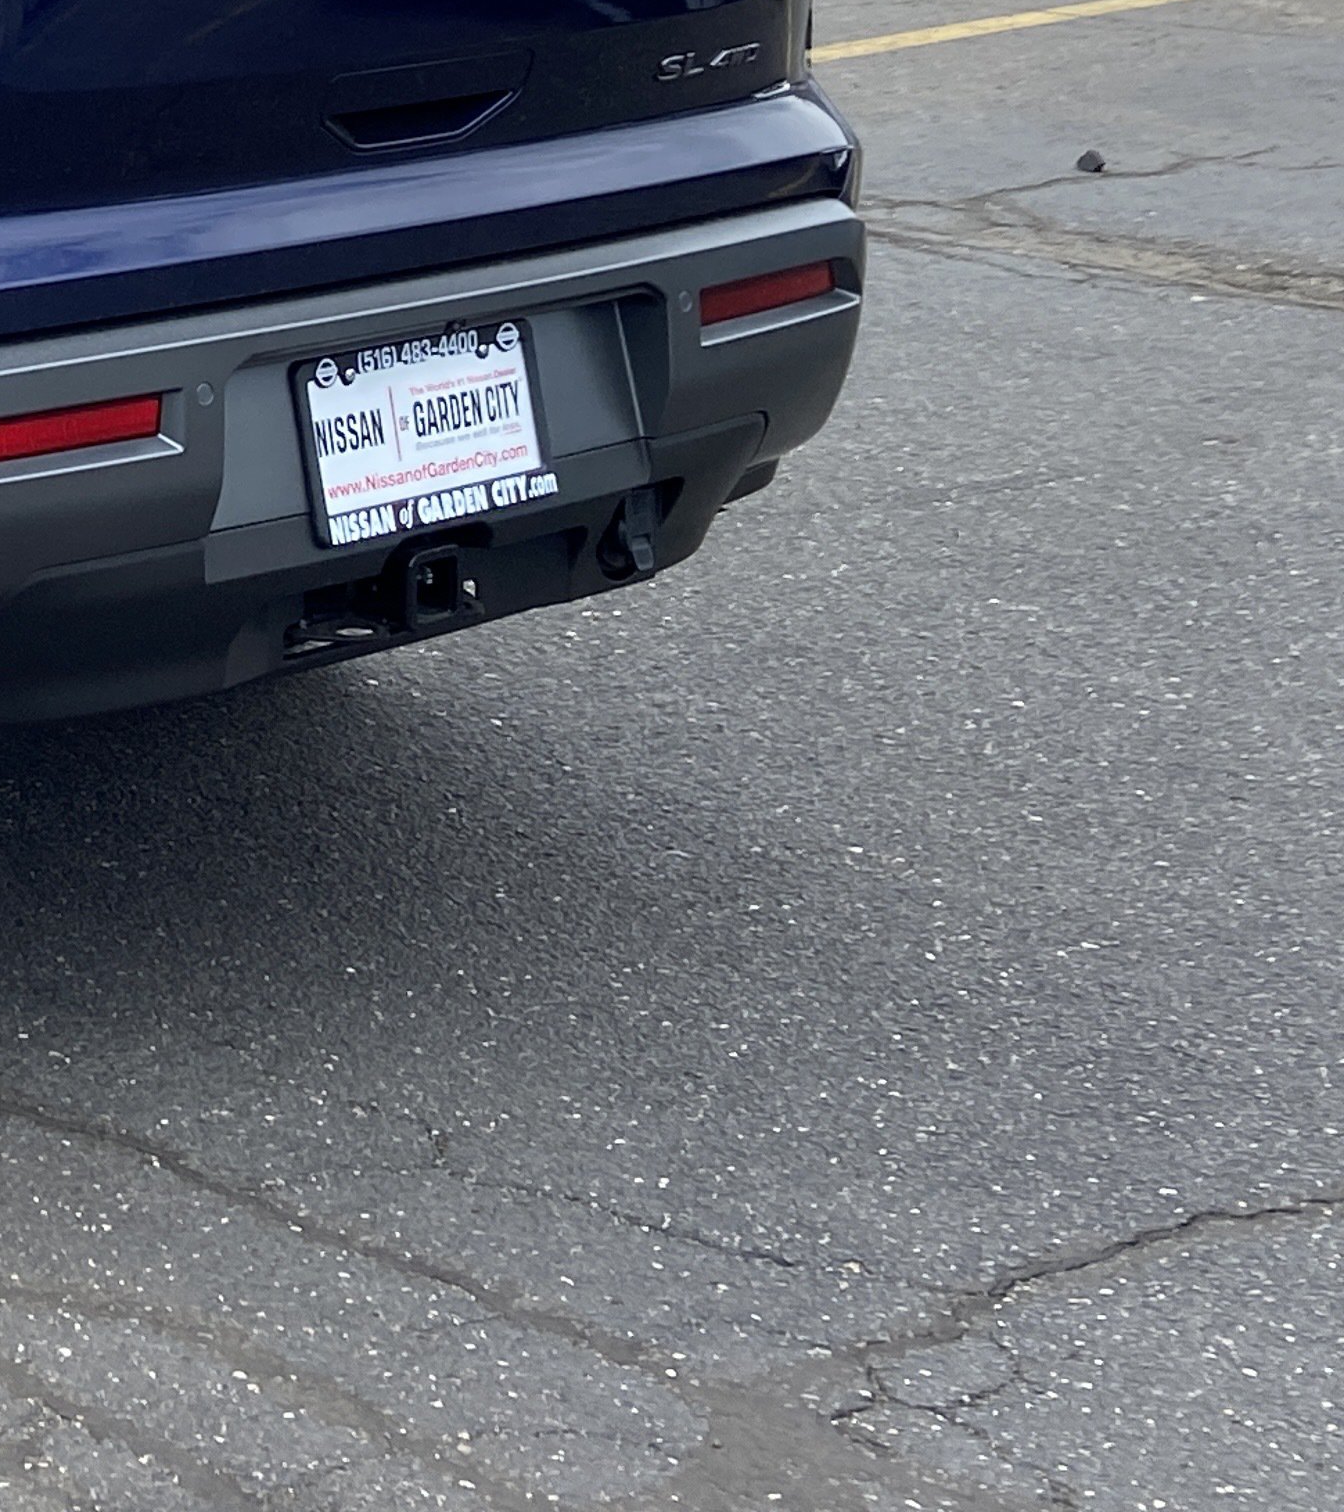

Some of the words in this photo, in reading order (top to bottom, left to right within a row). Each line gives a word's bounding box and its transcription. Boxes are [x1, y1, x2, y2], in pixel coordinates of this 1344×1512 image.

[656, 51, 705, 81] SL
[356, 346, 397, 373] (516)
[400, 329, 479, 365] 483-4400
[315, 408, 385, 458] NISSAN
[413, 388, 483, 437] GARDEN
[485, 379, 520, 422] CITY
[327, 444, 529, 499] www.NissanofGardenCity.com
[329, 504, 397, 546] NISSAN
[399, 499, 415, 529] of
[417, 484, 489, 525] GARDEN
[492, 472, 559, 508] CITY.com
